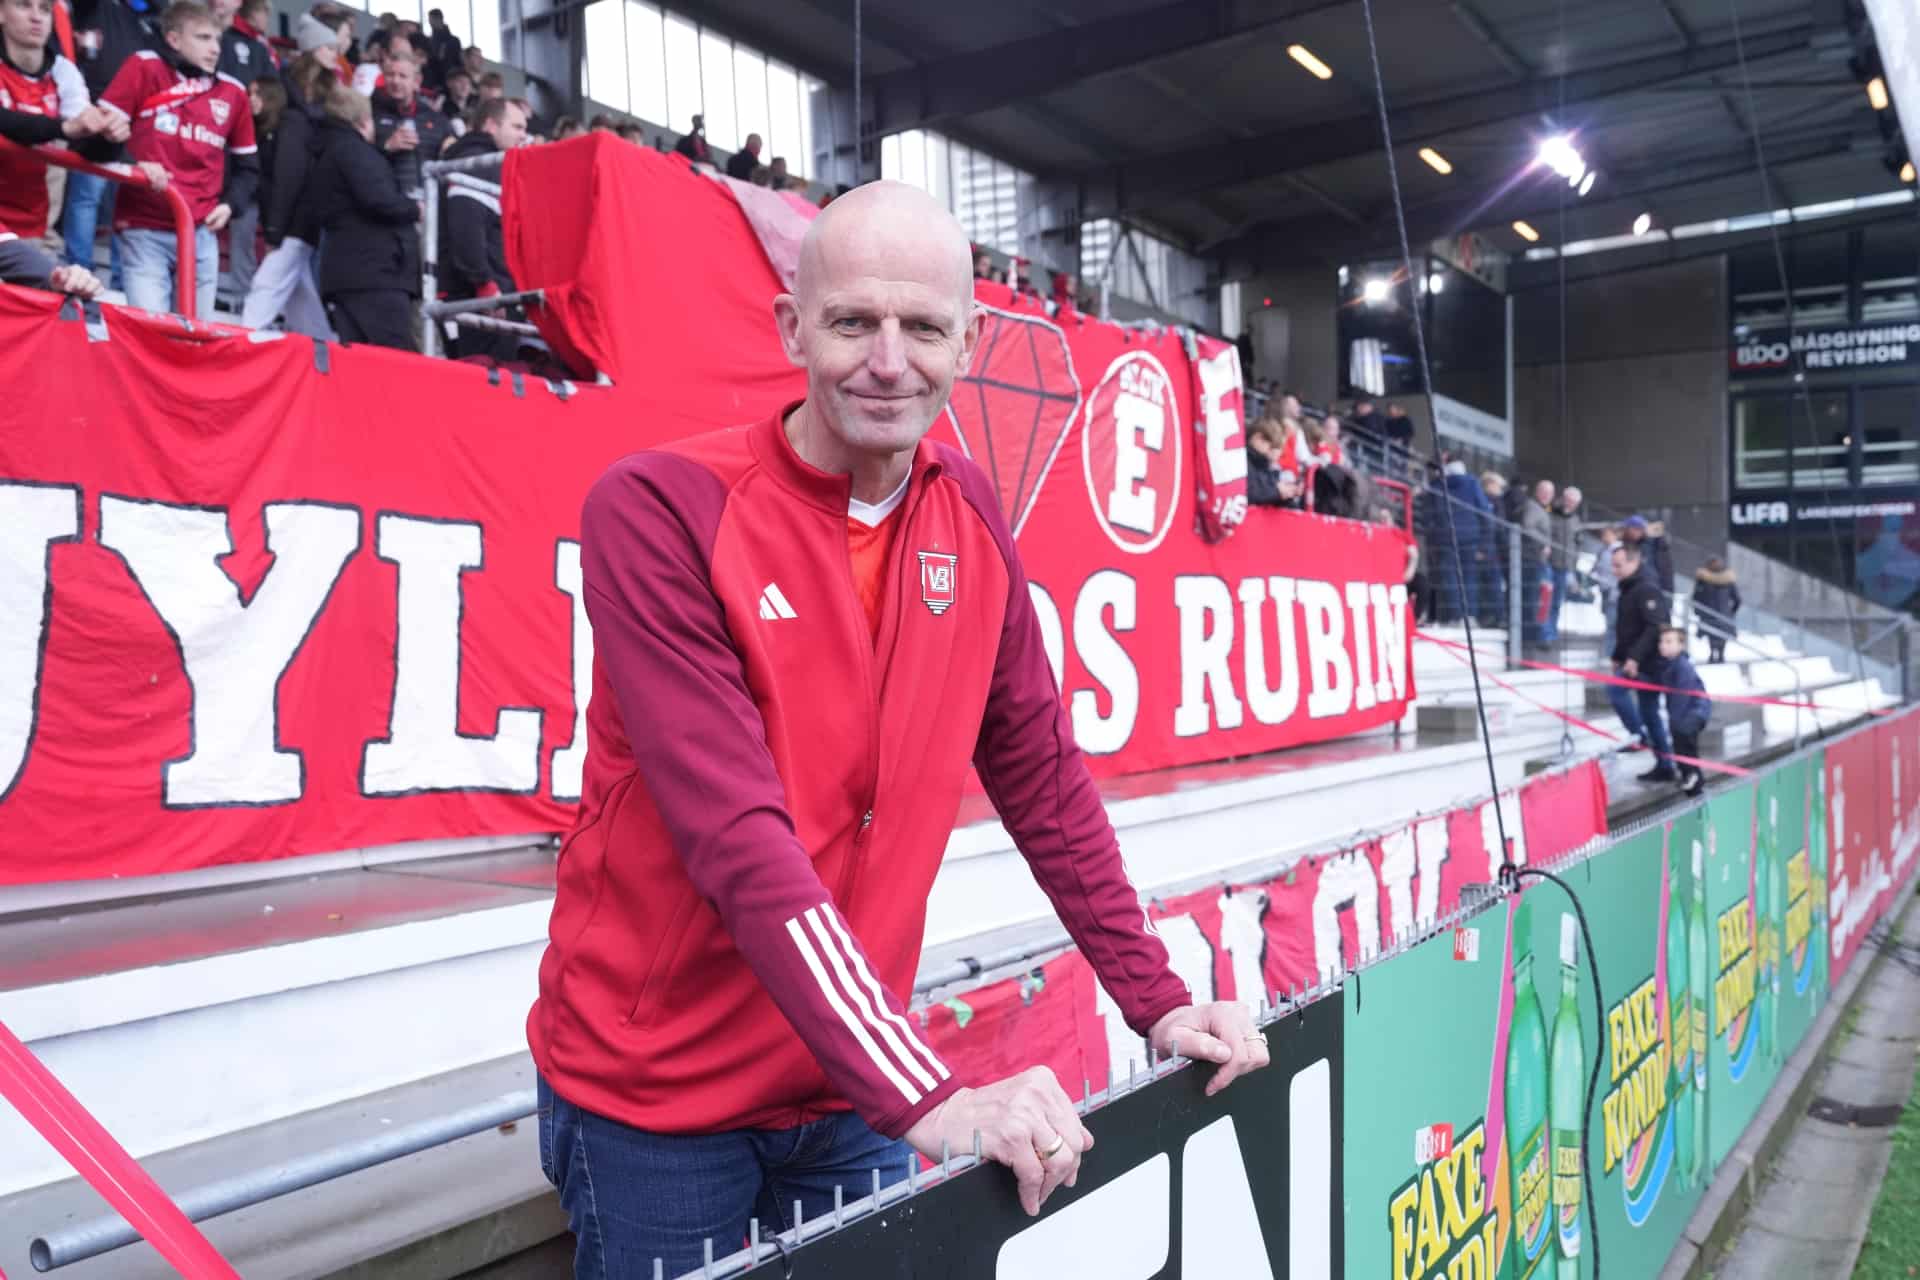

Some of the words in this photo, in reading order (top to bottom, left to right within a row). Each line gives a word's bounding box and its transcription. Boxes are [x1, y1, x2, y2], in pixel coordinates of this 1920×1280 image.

[1805, 344, 1907, 367] REVISION
[1108, 390, 1165, 536] E
[1731, 501, 1789, 525] LIFA
[927, 564, 950, 593] VB
[1174, 574, 1409, 737] RUBIN
[1608, 975, 1659, 1083] FAXE
[1602, 1042, 1666, 1174] KONDI
[1390, 1122, 1486, 1280] FAXE
